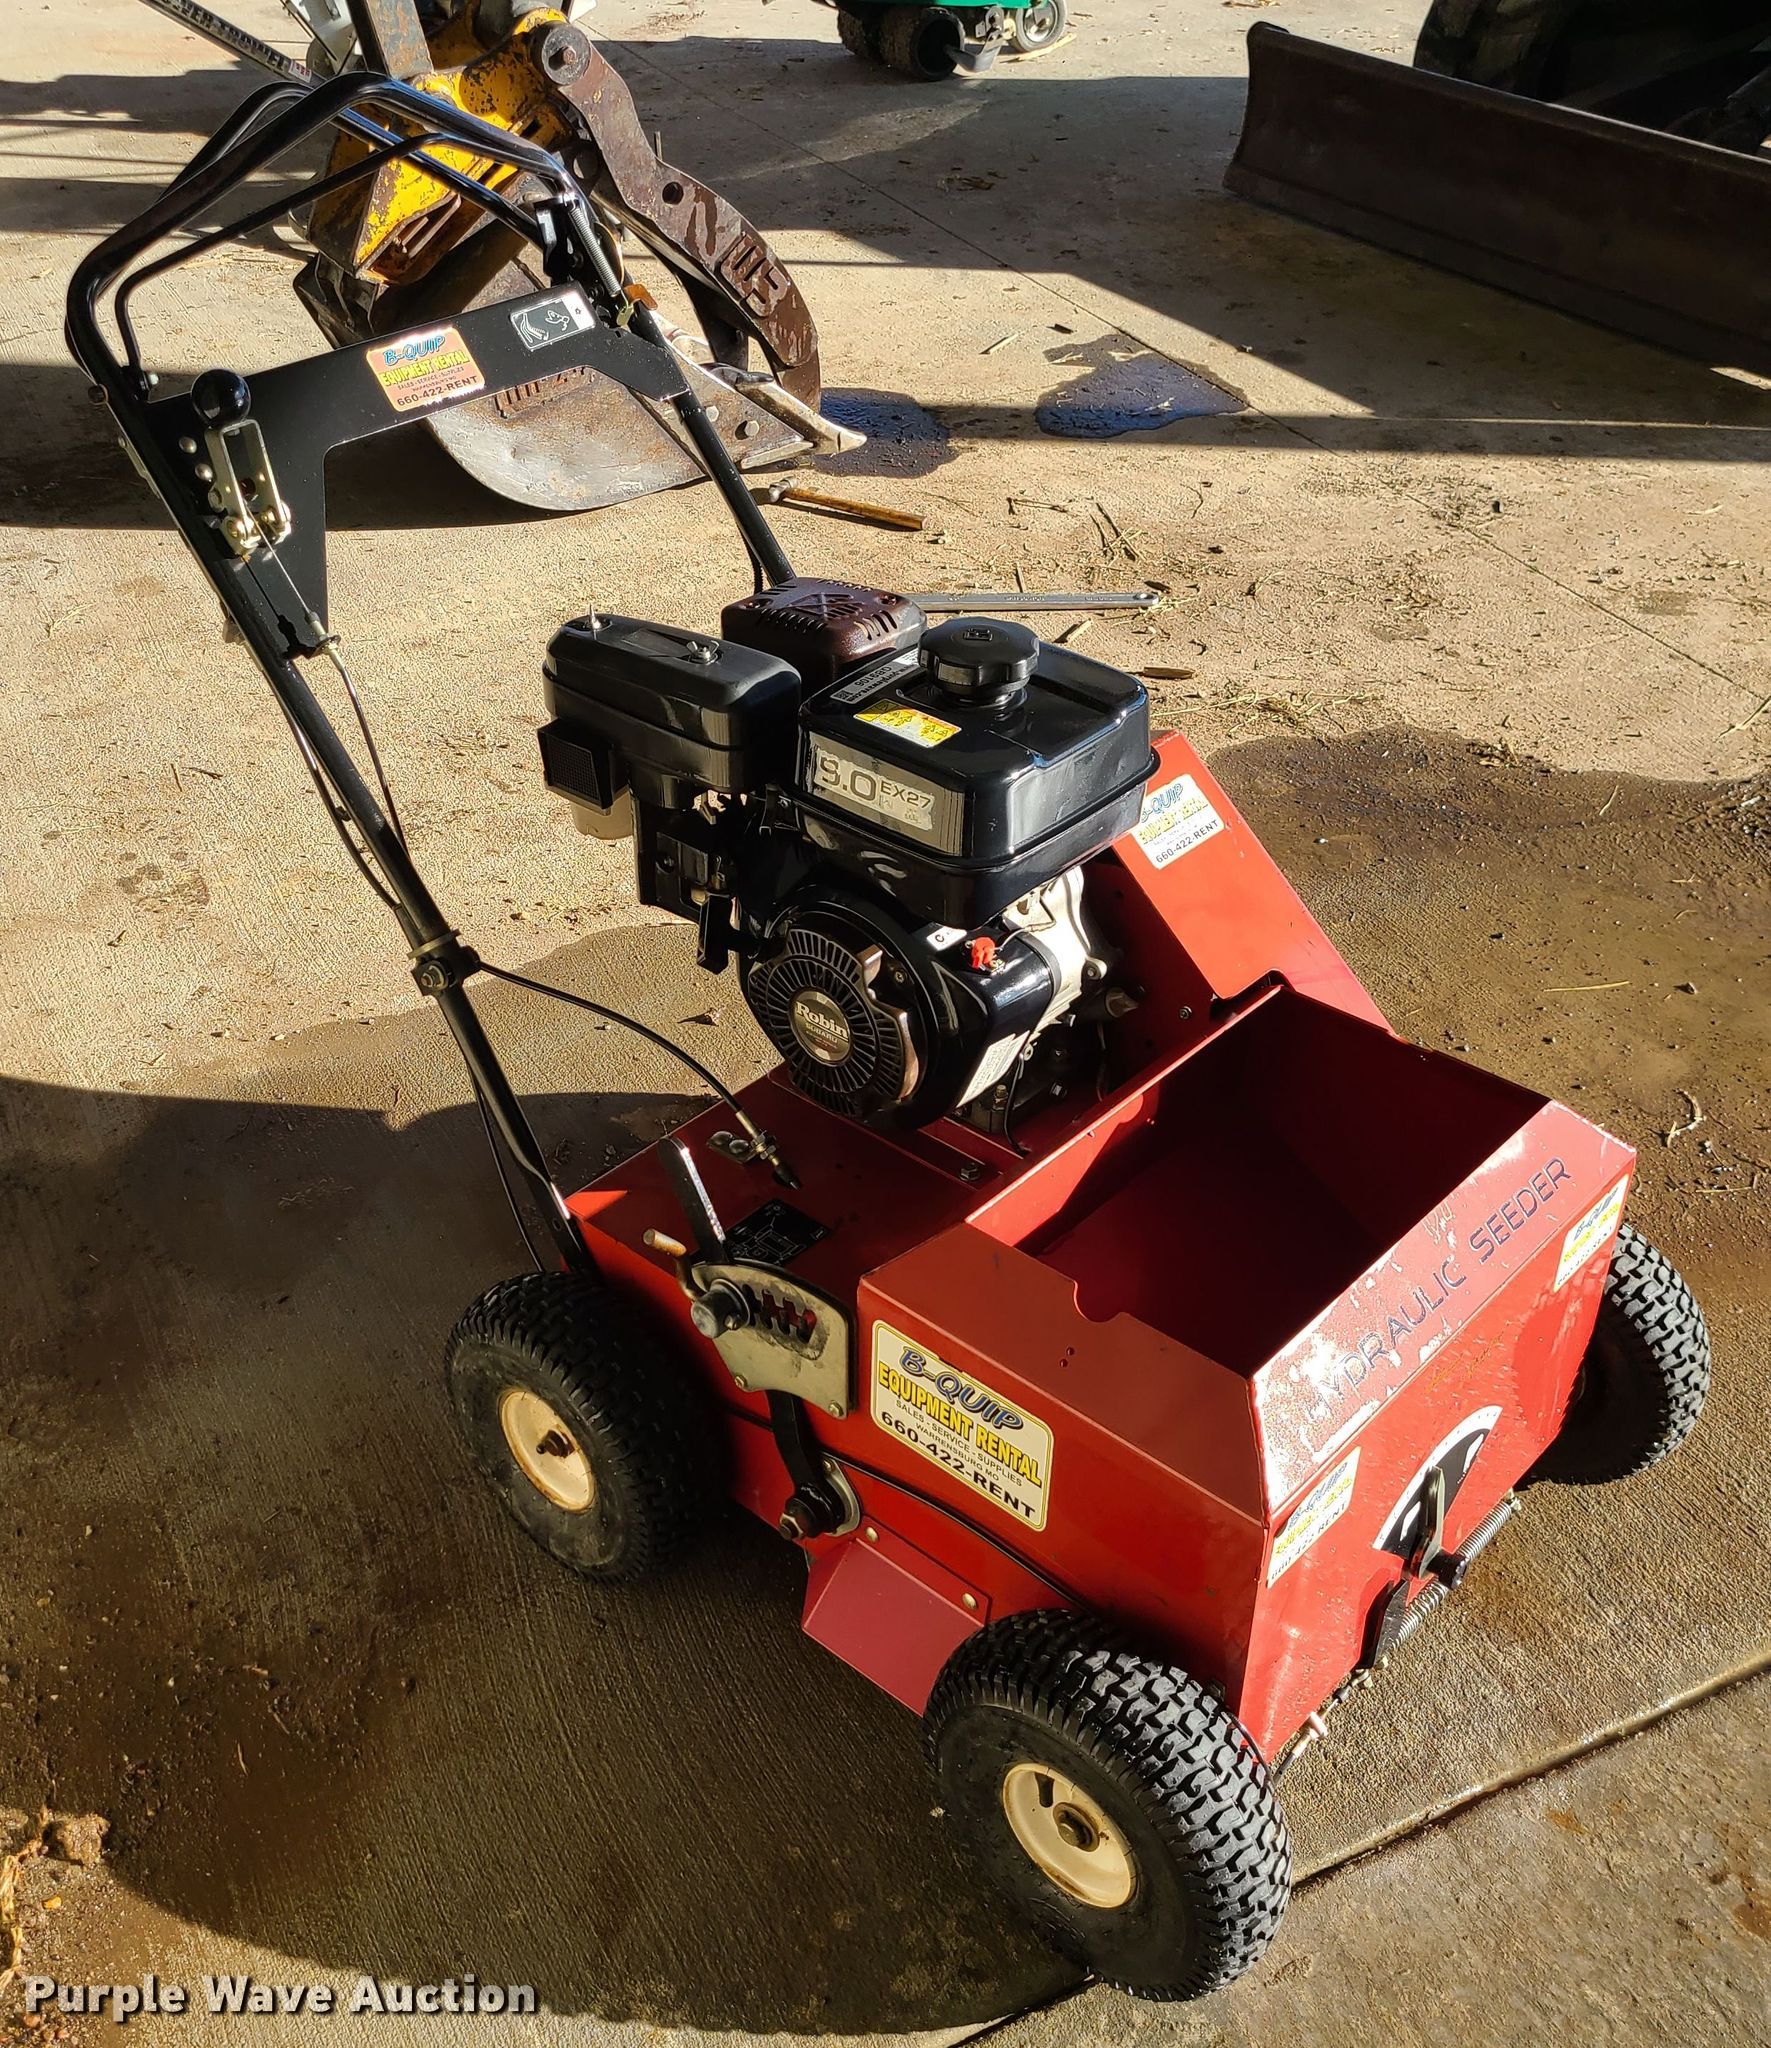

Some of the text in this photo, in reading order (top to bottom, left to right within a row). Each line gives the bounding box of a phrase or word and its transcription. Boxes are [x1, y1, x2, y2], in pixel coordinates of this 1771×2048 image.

[378, 350, 471, 387] EQUIPMENT RENTAL
[382, 335, 446, 367] B-QUIP
[397, 375, 478, 407] 660-422-RENT
[880, 780, 932, 809] EX27
[1155, 819, 1220, 864] 660-422-RENT
[796, 1001, 849, 1042] Robin
[1469, 1157, 1572, 1265] SEEDER
[899, 1346, 1024, 1430] B-QUIP
[878, 1361, 1042, 1489] EQUIPMENT RENTAL
[896, 1399, 925, 1422] SALES
[931, 1422, 970, 1452] SERVICE
[977, 1450, 1023, 1488] SUPPLIES
[881, 1411, 1036, 1519] 660-422-RENT
[916, 1422, 1000, 1481] WARRENSBURG MO
